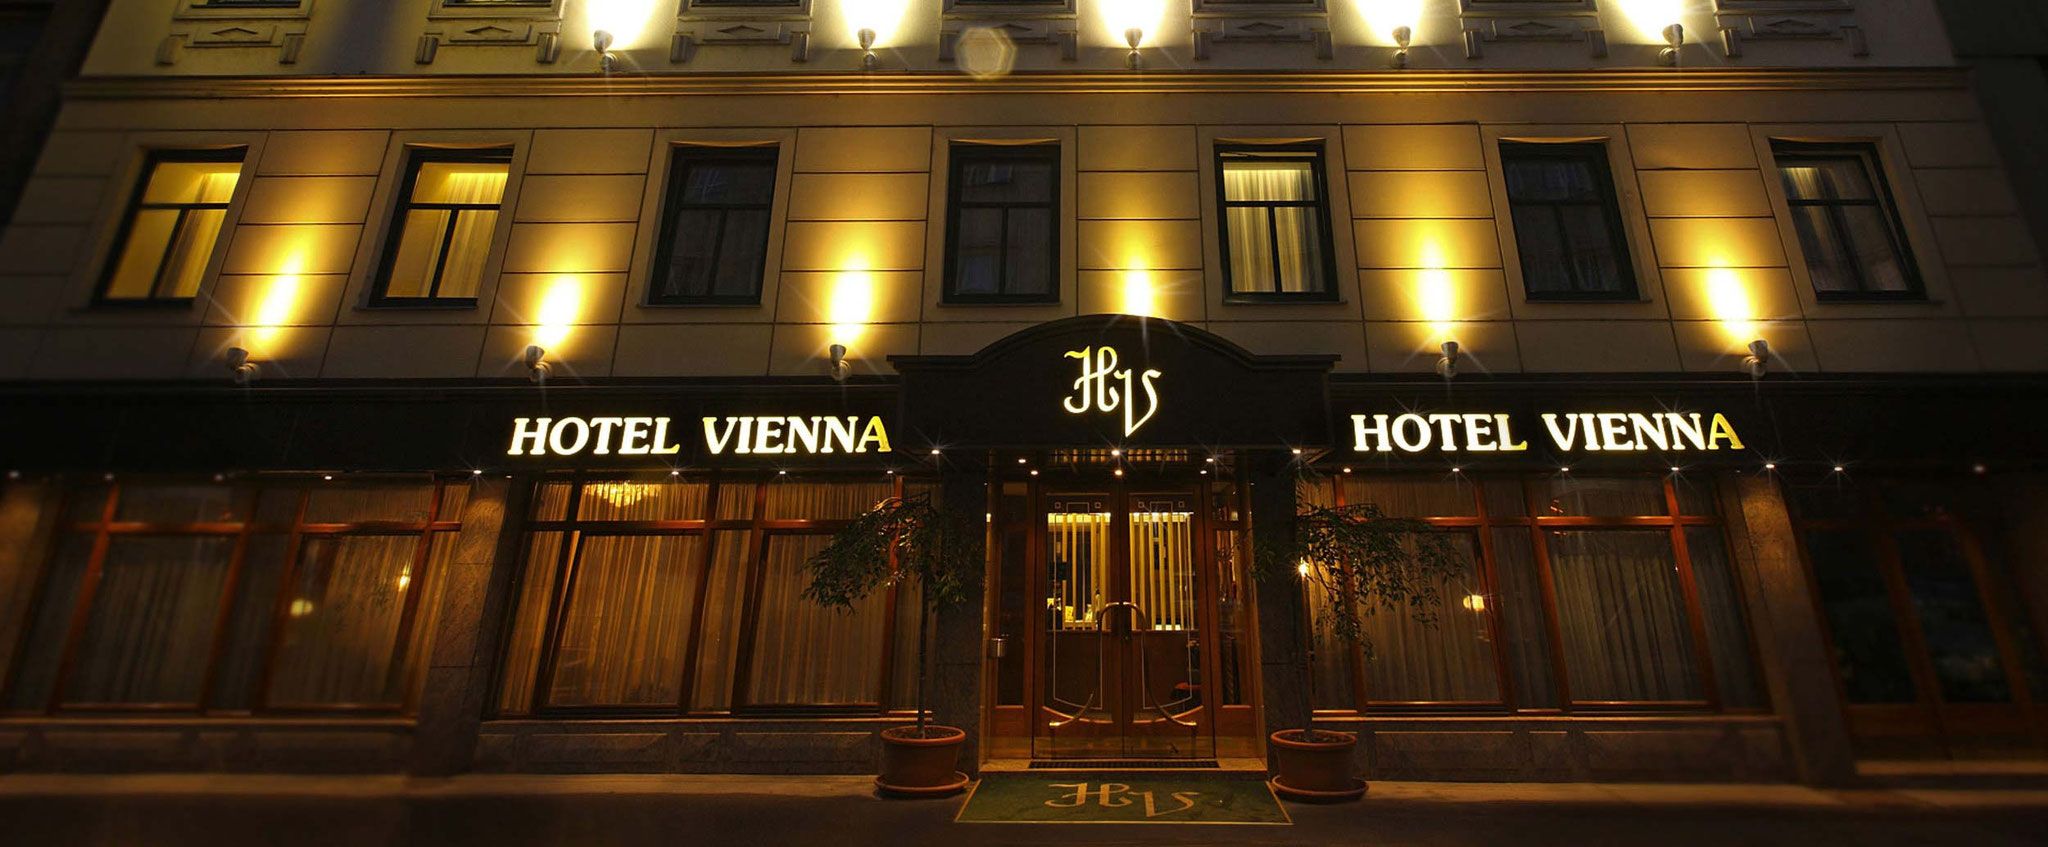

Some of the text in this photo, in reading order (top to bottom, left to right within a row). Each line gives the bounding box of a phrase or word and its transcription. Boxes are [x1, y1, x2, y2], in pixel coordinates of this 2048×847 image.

[507, 414, 892, 455] HOTEL VIENNA
[1350, 412, 1746, 452] HOTEL VIENNA
